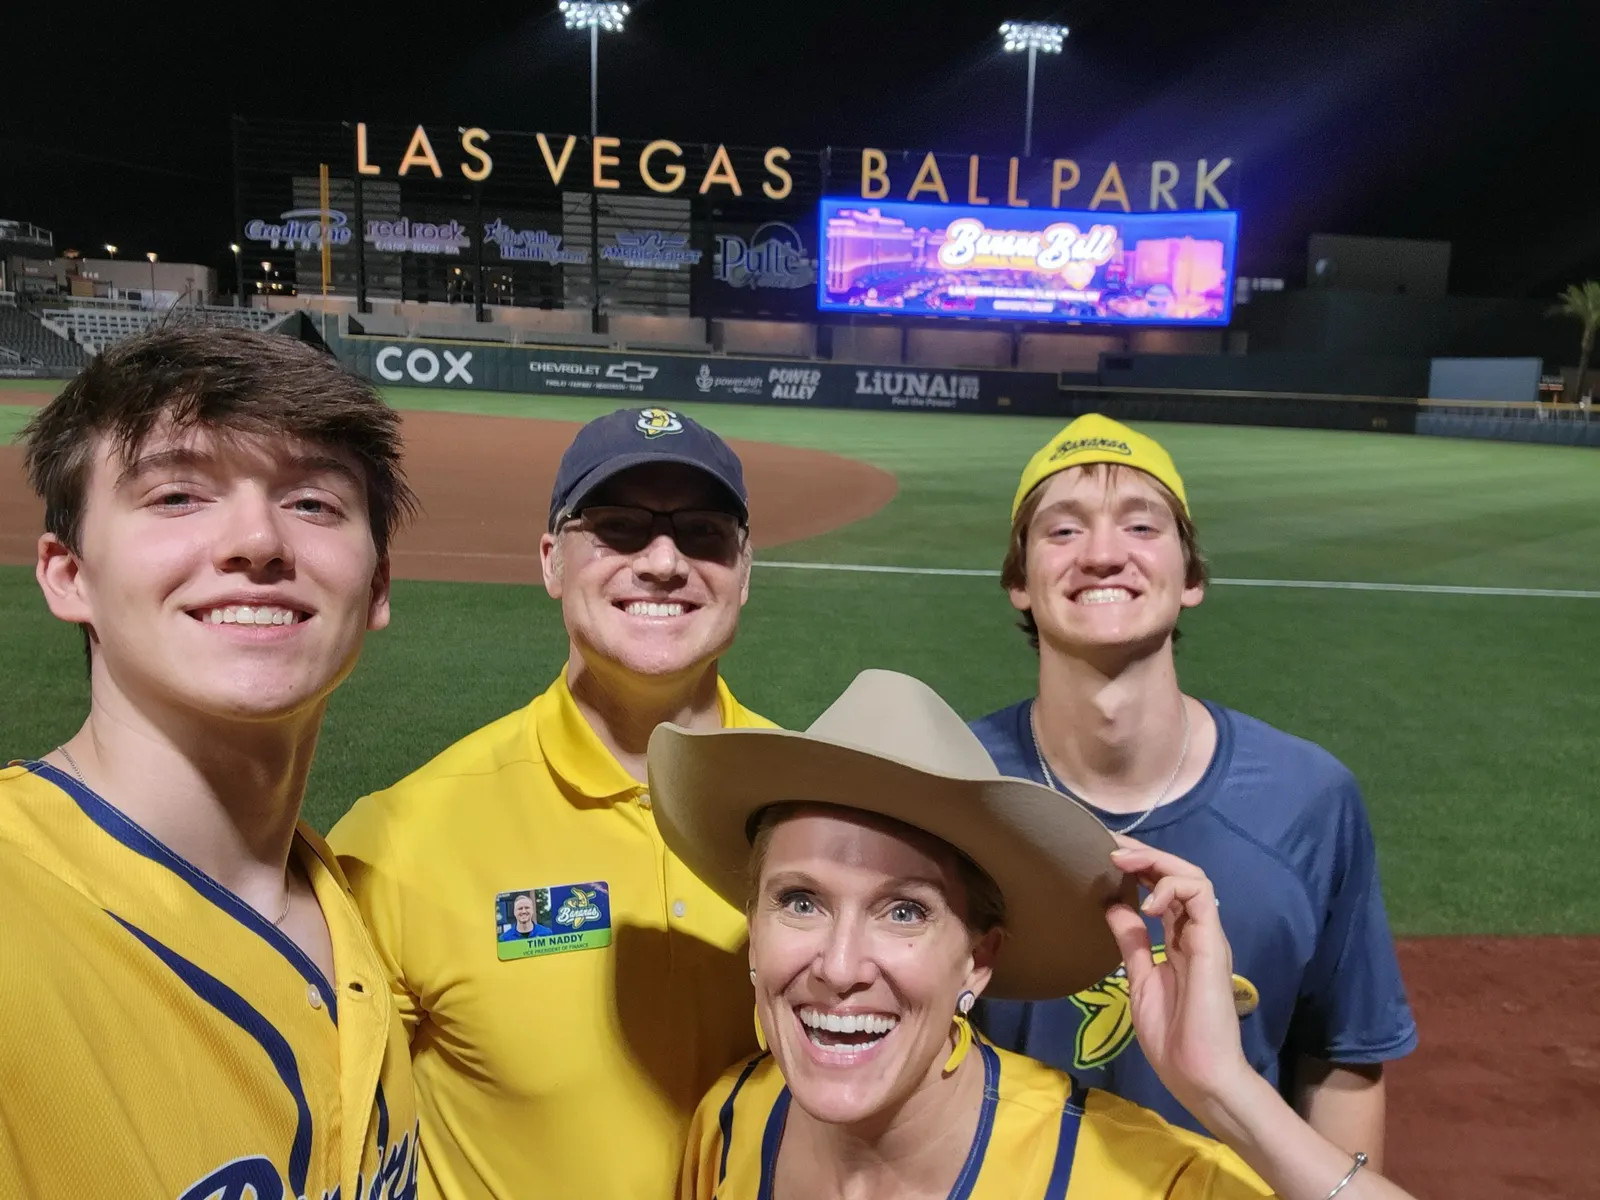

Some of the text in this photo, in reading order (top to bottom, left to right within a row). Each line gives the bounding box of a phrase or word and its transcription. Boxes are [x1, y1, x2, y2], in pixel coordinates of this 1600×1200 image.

[357, 122, 1233, 213] LAS VEGAS BALLPARK
[366, 216, 466, 242] red rock
[715, 234, 801, 281] Pulte
[941, 221, 1116, 270] Banana Ball
[376, 346, 473, 384] COX
[529, 361, 602, 376] CHEVROLET
[768, 367, 822, 387] POWER
[771, 383, 817, 400] ALLEY
[855, 370, 958, 399] LiUNA!
[557, 906, 601, 925] Bananas
[527, 933, 584, 948] TIM NADDY
